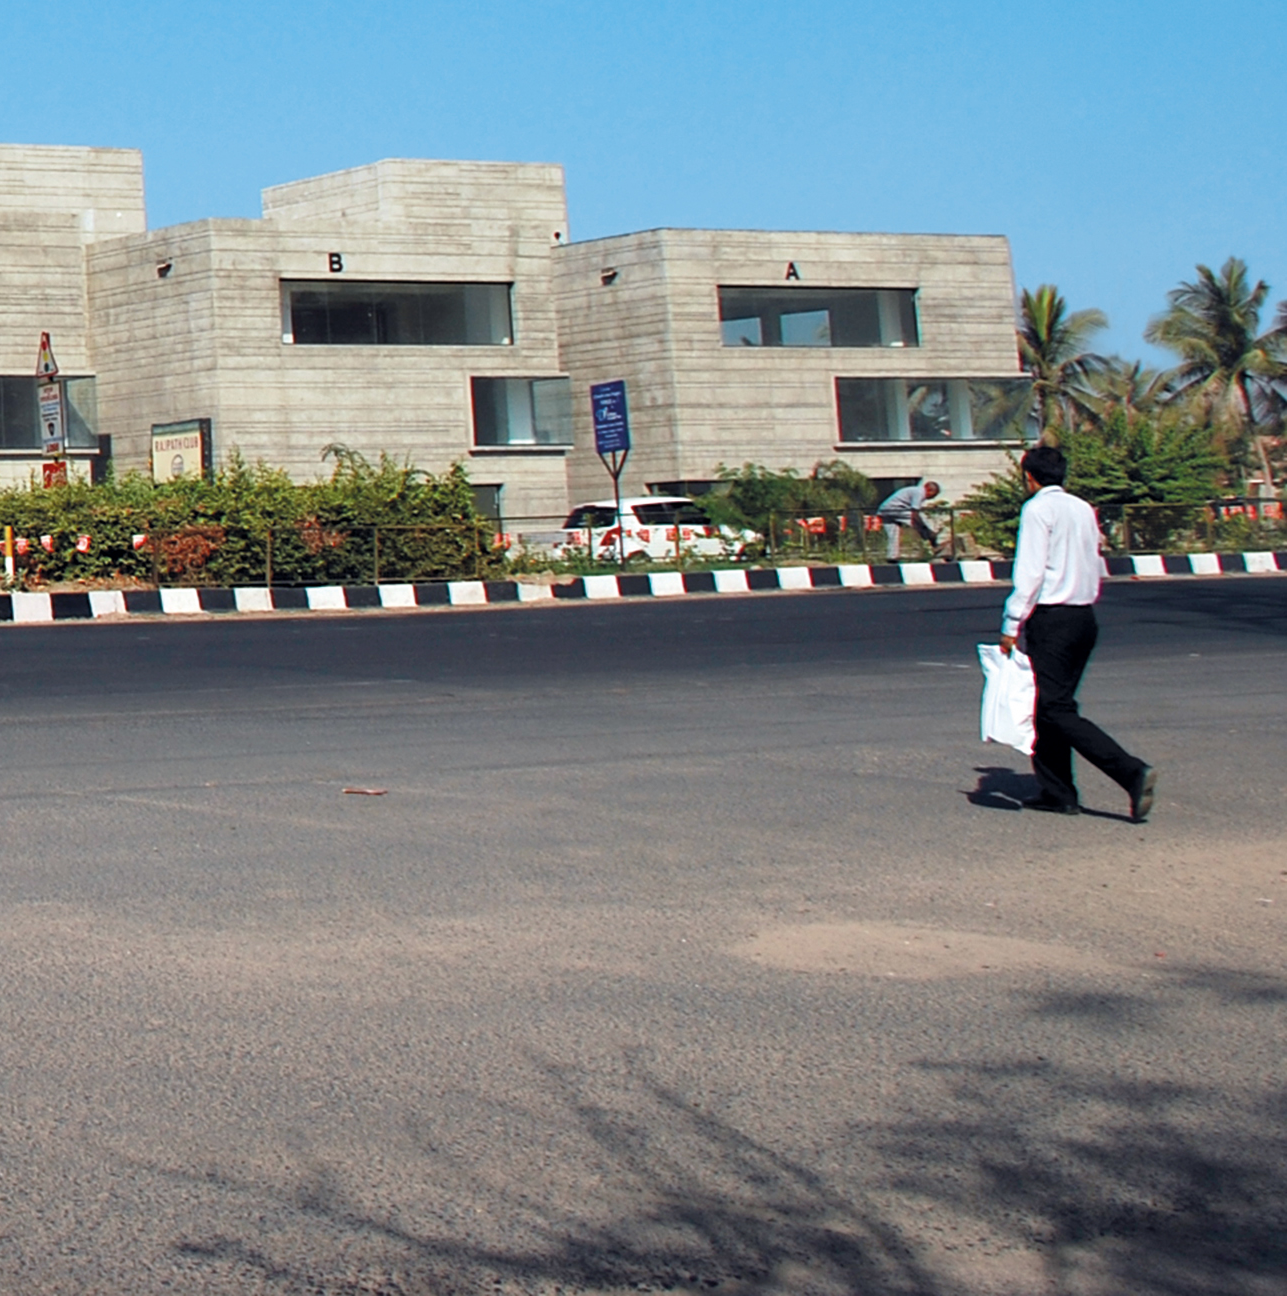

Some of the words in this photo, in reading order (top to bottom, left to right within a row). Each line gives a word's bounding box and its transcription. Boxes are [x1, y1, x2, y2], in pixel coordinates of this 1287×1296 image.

[329, 253, 343, 273] B
[785, 261, 800, 280] A
[183, 436, 199, 449] CLUB
